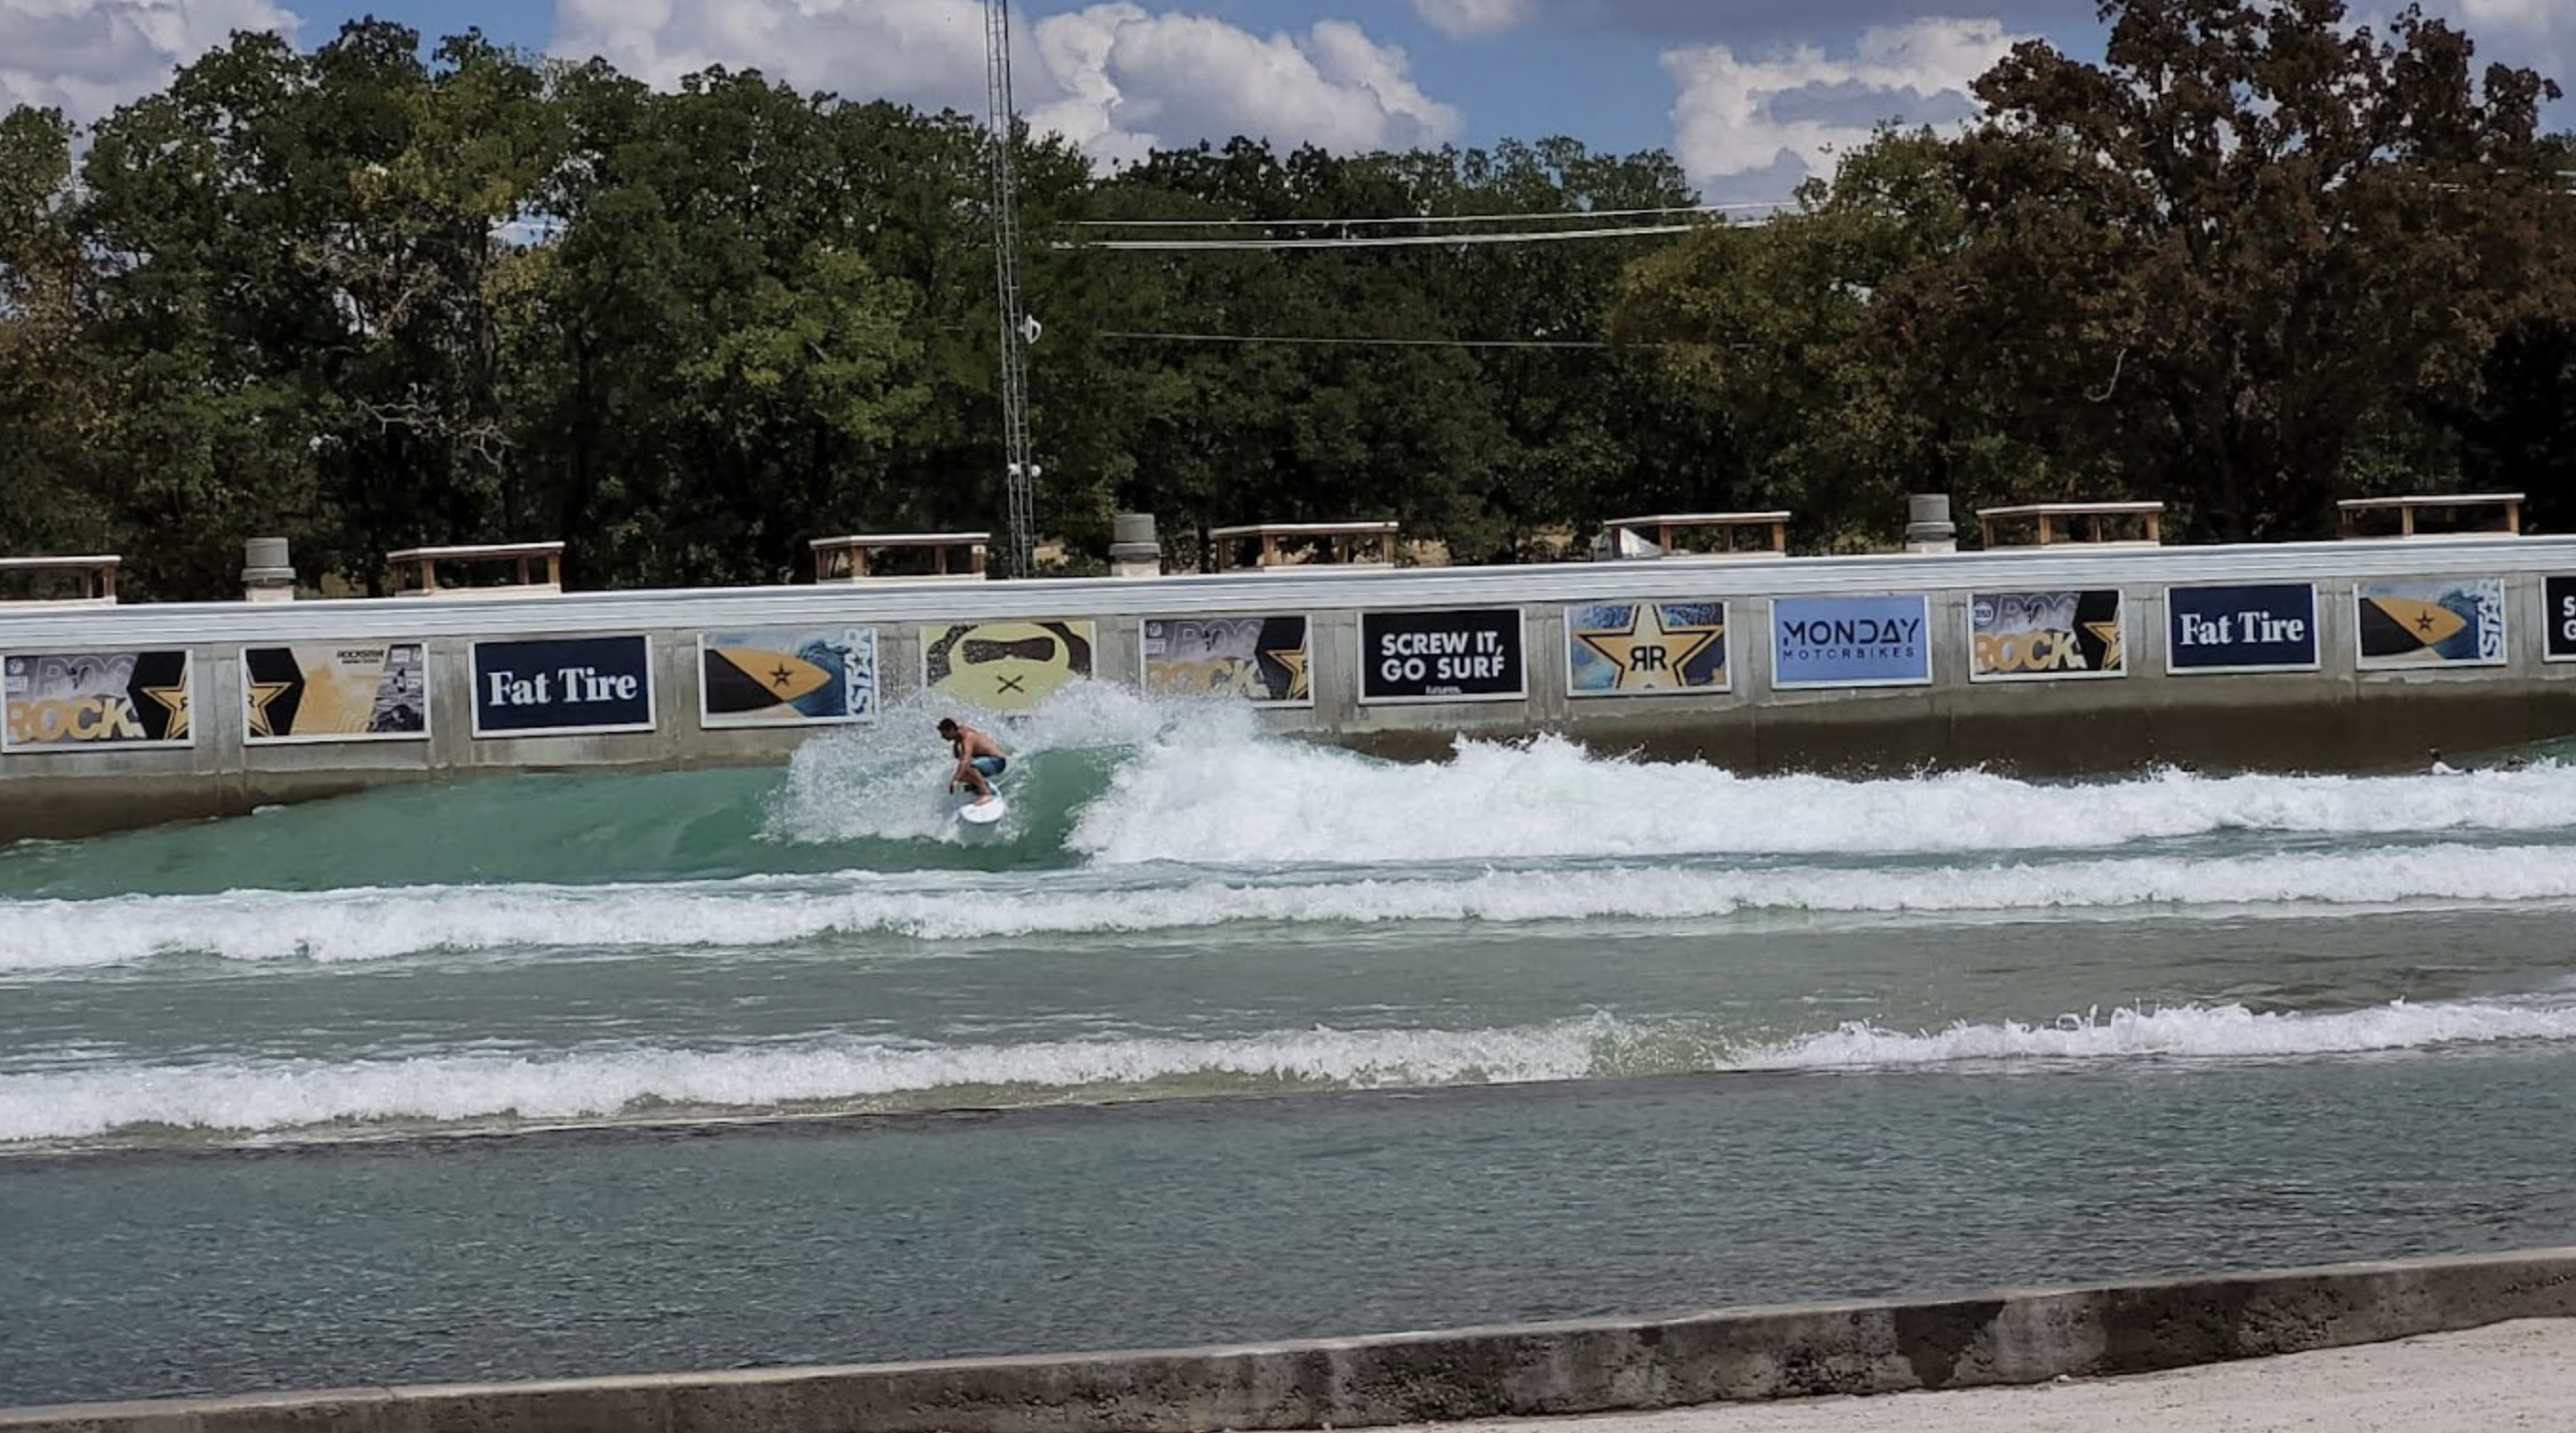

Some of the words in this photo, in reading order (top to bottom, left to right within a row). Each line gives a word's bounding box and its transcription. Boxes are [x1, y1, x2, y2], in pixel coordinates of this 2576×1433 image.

[1783, 618, 1921, 646] MONDAY
[2178, 613, 2234, 646] Fat
[2237, 611, 2305, 643] Tire
[1381, 632, 1469, 657] SCREW
[1475, 631, 1505, 656] IT,
[1783, 647, 1914, 661] MOTORBIKES
[1381, 658, 1427, 682] GO
[1436, 656, 1505, 679] SURF
[487, 670, 552, 706] Fat
[557, 667, 637, 702] Tire
